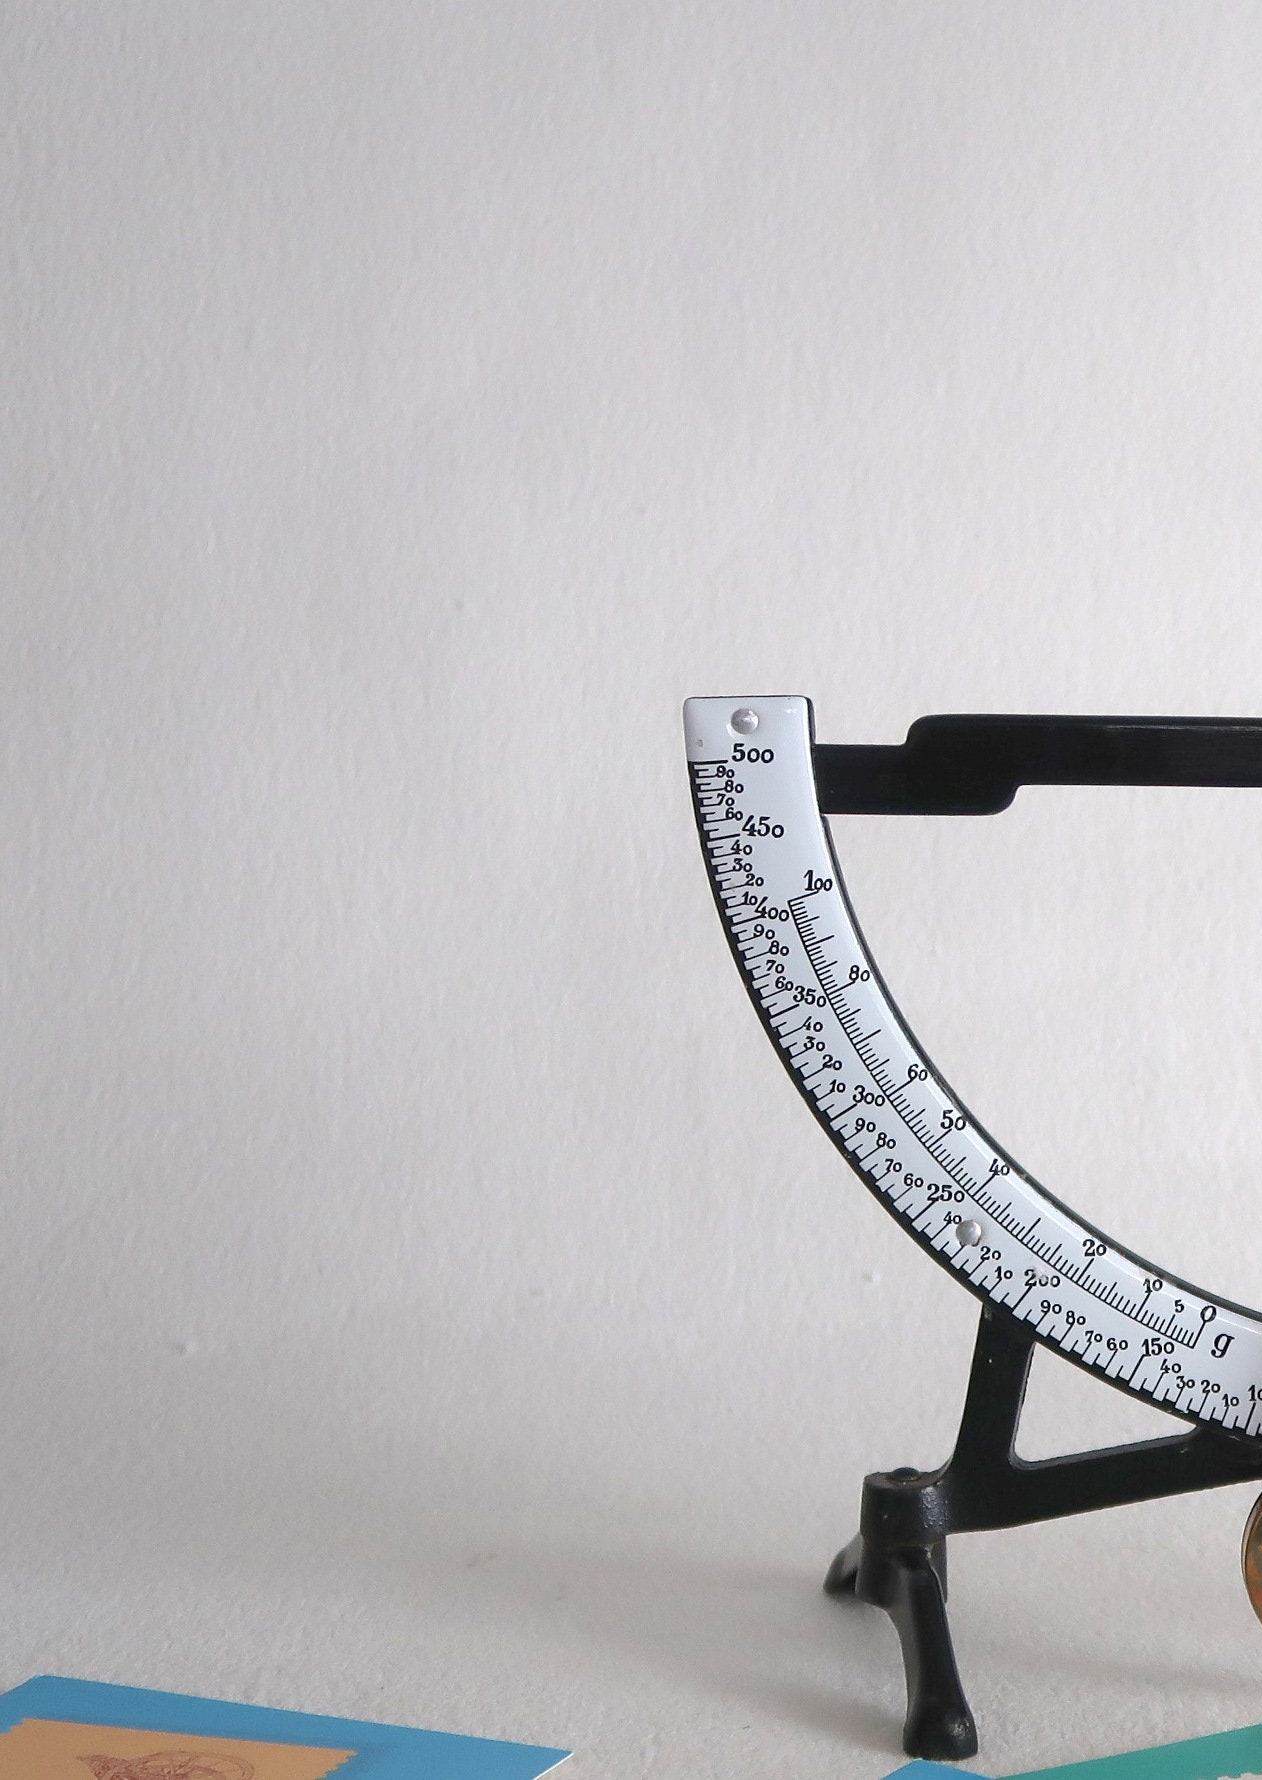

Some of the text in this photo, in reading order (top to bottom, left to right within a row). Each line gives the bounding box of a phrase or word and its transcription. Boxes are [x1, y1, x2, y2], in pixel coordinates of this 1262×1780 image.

[732, 743, 774, 763] 500
[716, 766, 734, 778] 90
[725, 780, 744, 793] 80
[717, 794, 734, 806] 70
[725, 808, 743, 821] 60
[742, 815, 784, 838] 450
[731, 840, 752, 855] 40
[732, 858, 752, 872] 30
[745, 874, 764, 887] 20
[803, 870, 832, 891] 100
[742, 892, 757, 905] 10
[755, 897, 789, 921] 400
[753, 924, 775, 940] 90
[769, 940, 789, 956] 80
[766, 960, 784, 974] 70
[849, 965, 870, 982] 80
[775, 976, 793, 991] 60
[793, 986, 826, 1008] 350
[801, 1016, 823, 1032] 40
[804, 1036, 825, 1051] 30
[822, 1054, 842, 1070] 20
[908, 1064, 927, 1081] 60
[829, 1080, 845, 1092] 10
[853, 1085, 885, 1106] 300
[855, 1118, 876, 1132] 90
[940, 1110, 966, 1130] 50
[876, 1133, 896, 1149] 80
[885, 1159, 902, 1172] 70
[989, 1159, 1010, 1176] 40
[904, 1173, 923, 1188] 60
[927, 1184, 965, 1202] 250
[943, 1211, 962, 1224] 40
[980, 1246, 1001, 1260] 20
[1083, 1239, 1106, 1256] 20
[995, 1266, 1013, 1280] 10
[1024, 1269, 1060, 1287] 200
[1143, 1278, 1162, 1293] 10
[1041, 1300, 1062, 1314] 90
[1174, 1300, 1184, 1313] 5
[1201, 1306, 1216, 1322] 0
[1066, 1311, 1086, 1325] 80
[1085, 1331, 1102, 1343] 70
[1107, 1338, 1128, 1350] 60
[1142, 1338, 1174, 1356] 150
[1211, 1333, 1235, 1358] g
[1160, 1359, 1181, 1373] 40
[1176, 1376, 1195, 1389] 30
[1201, 1380, 1220, 1393] 20
[1223, 1394, 1239, 1407] 10
